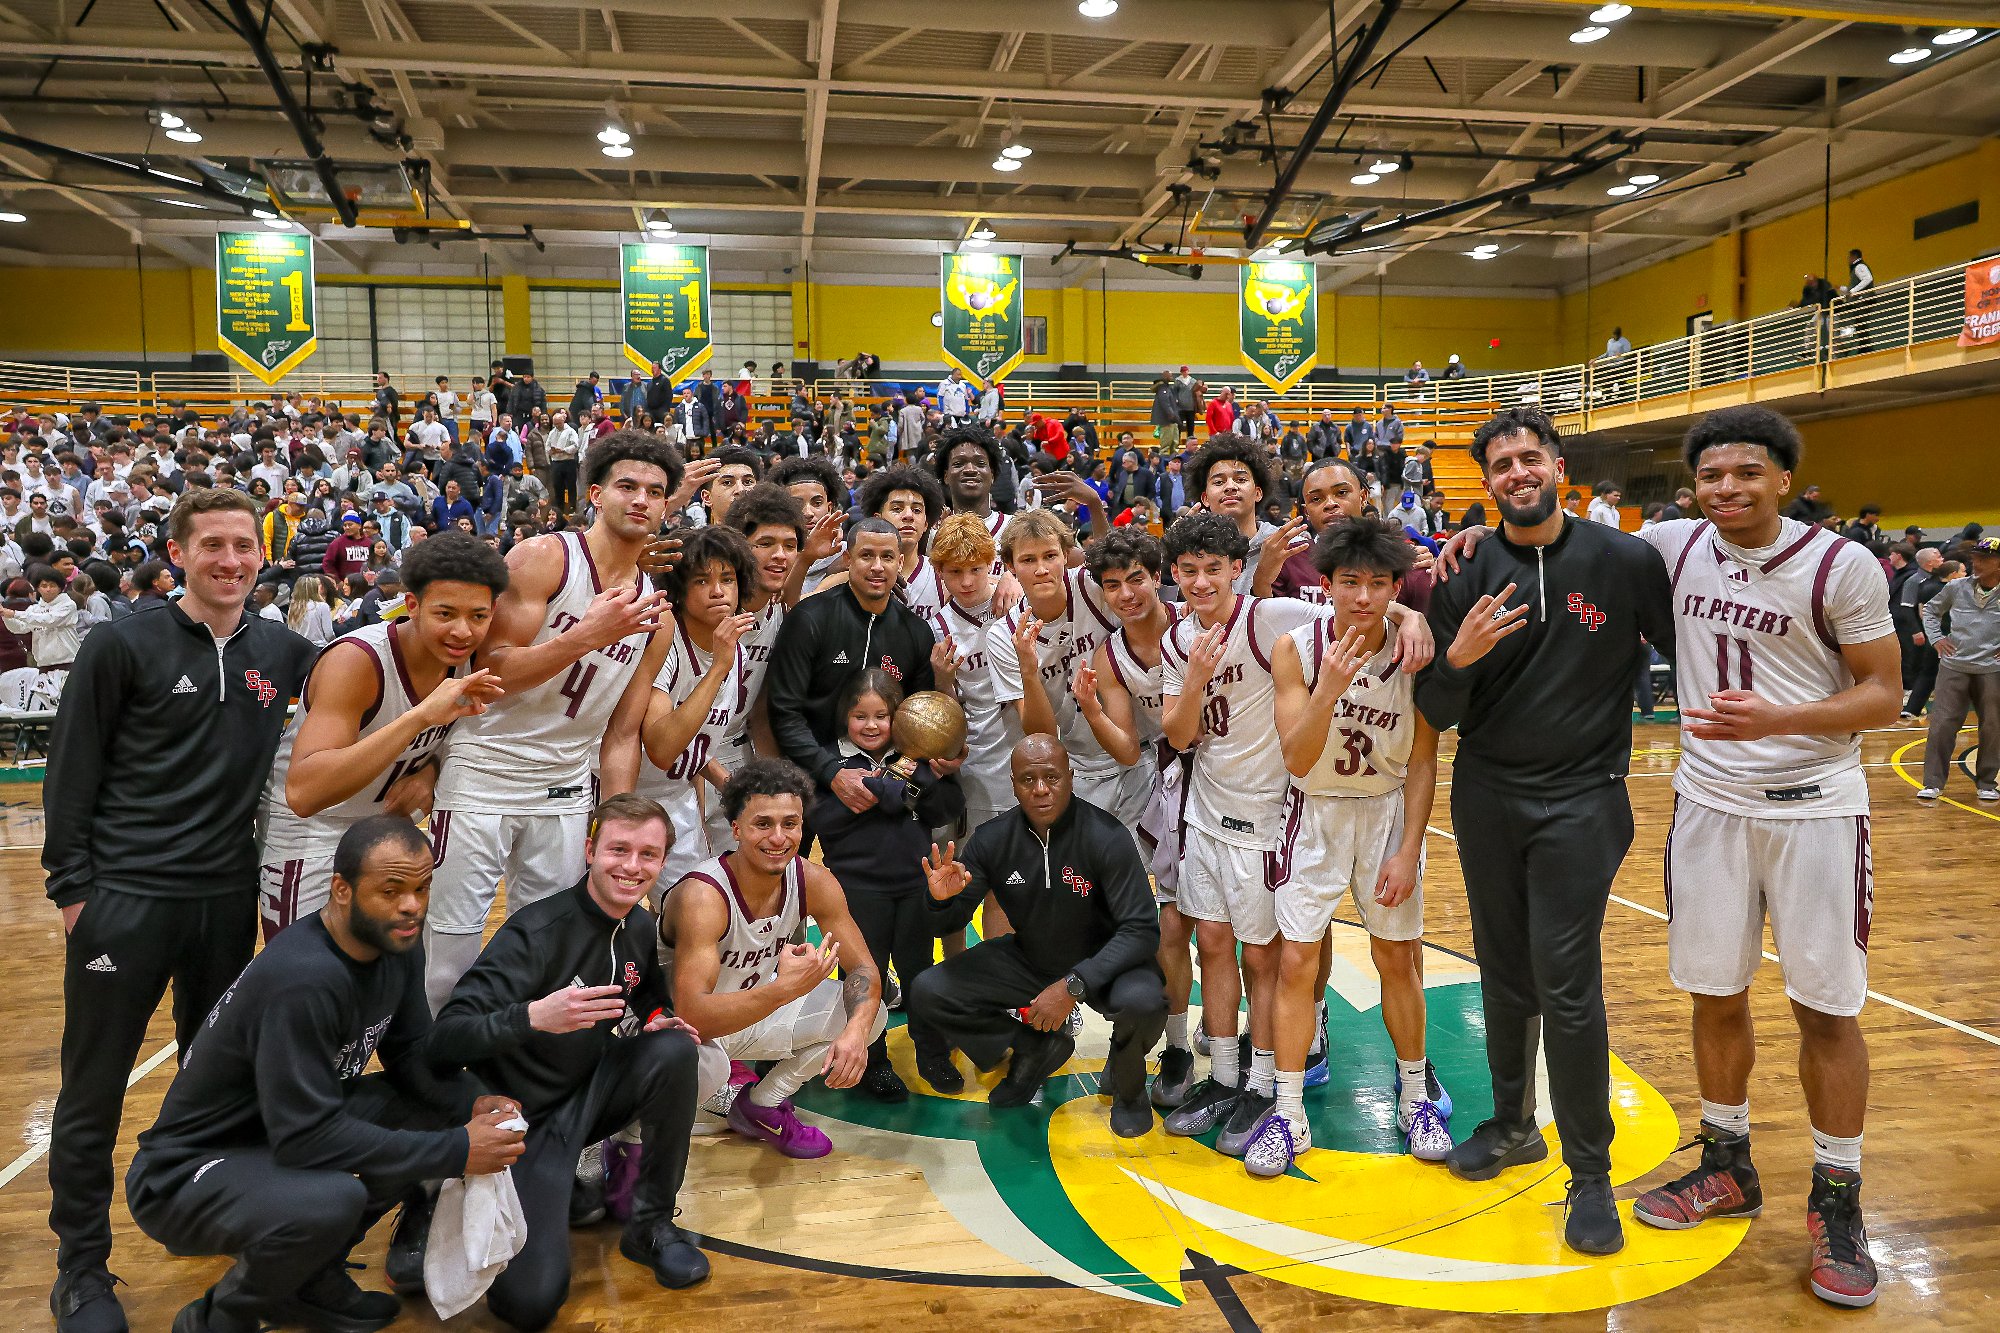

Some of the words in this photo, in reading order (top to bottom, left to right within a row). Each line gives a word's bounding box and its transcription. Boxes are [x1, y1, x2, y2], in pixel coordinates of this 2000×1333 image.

[1567, 592, 1607, 632] SFP
[1715, 633, 1753, 692] 11
[244, 669, 278, 708] SFP
[560, 660, 599, 720] 4
[1062, 866, 1094, 898] SFP
[85, 963, 118, 972] adidas
